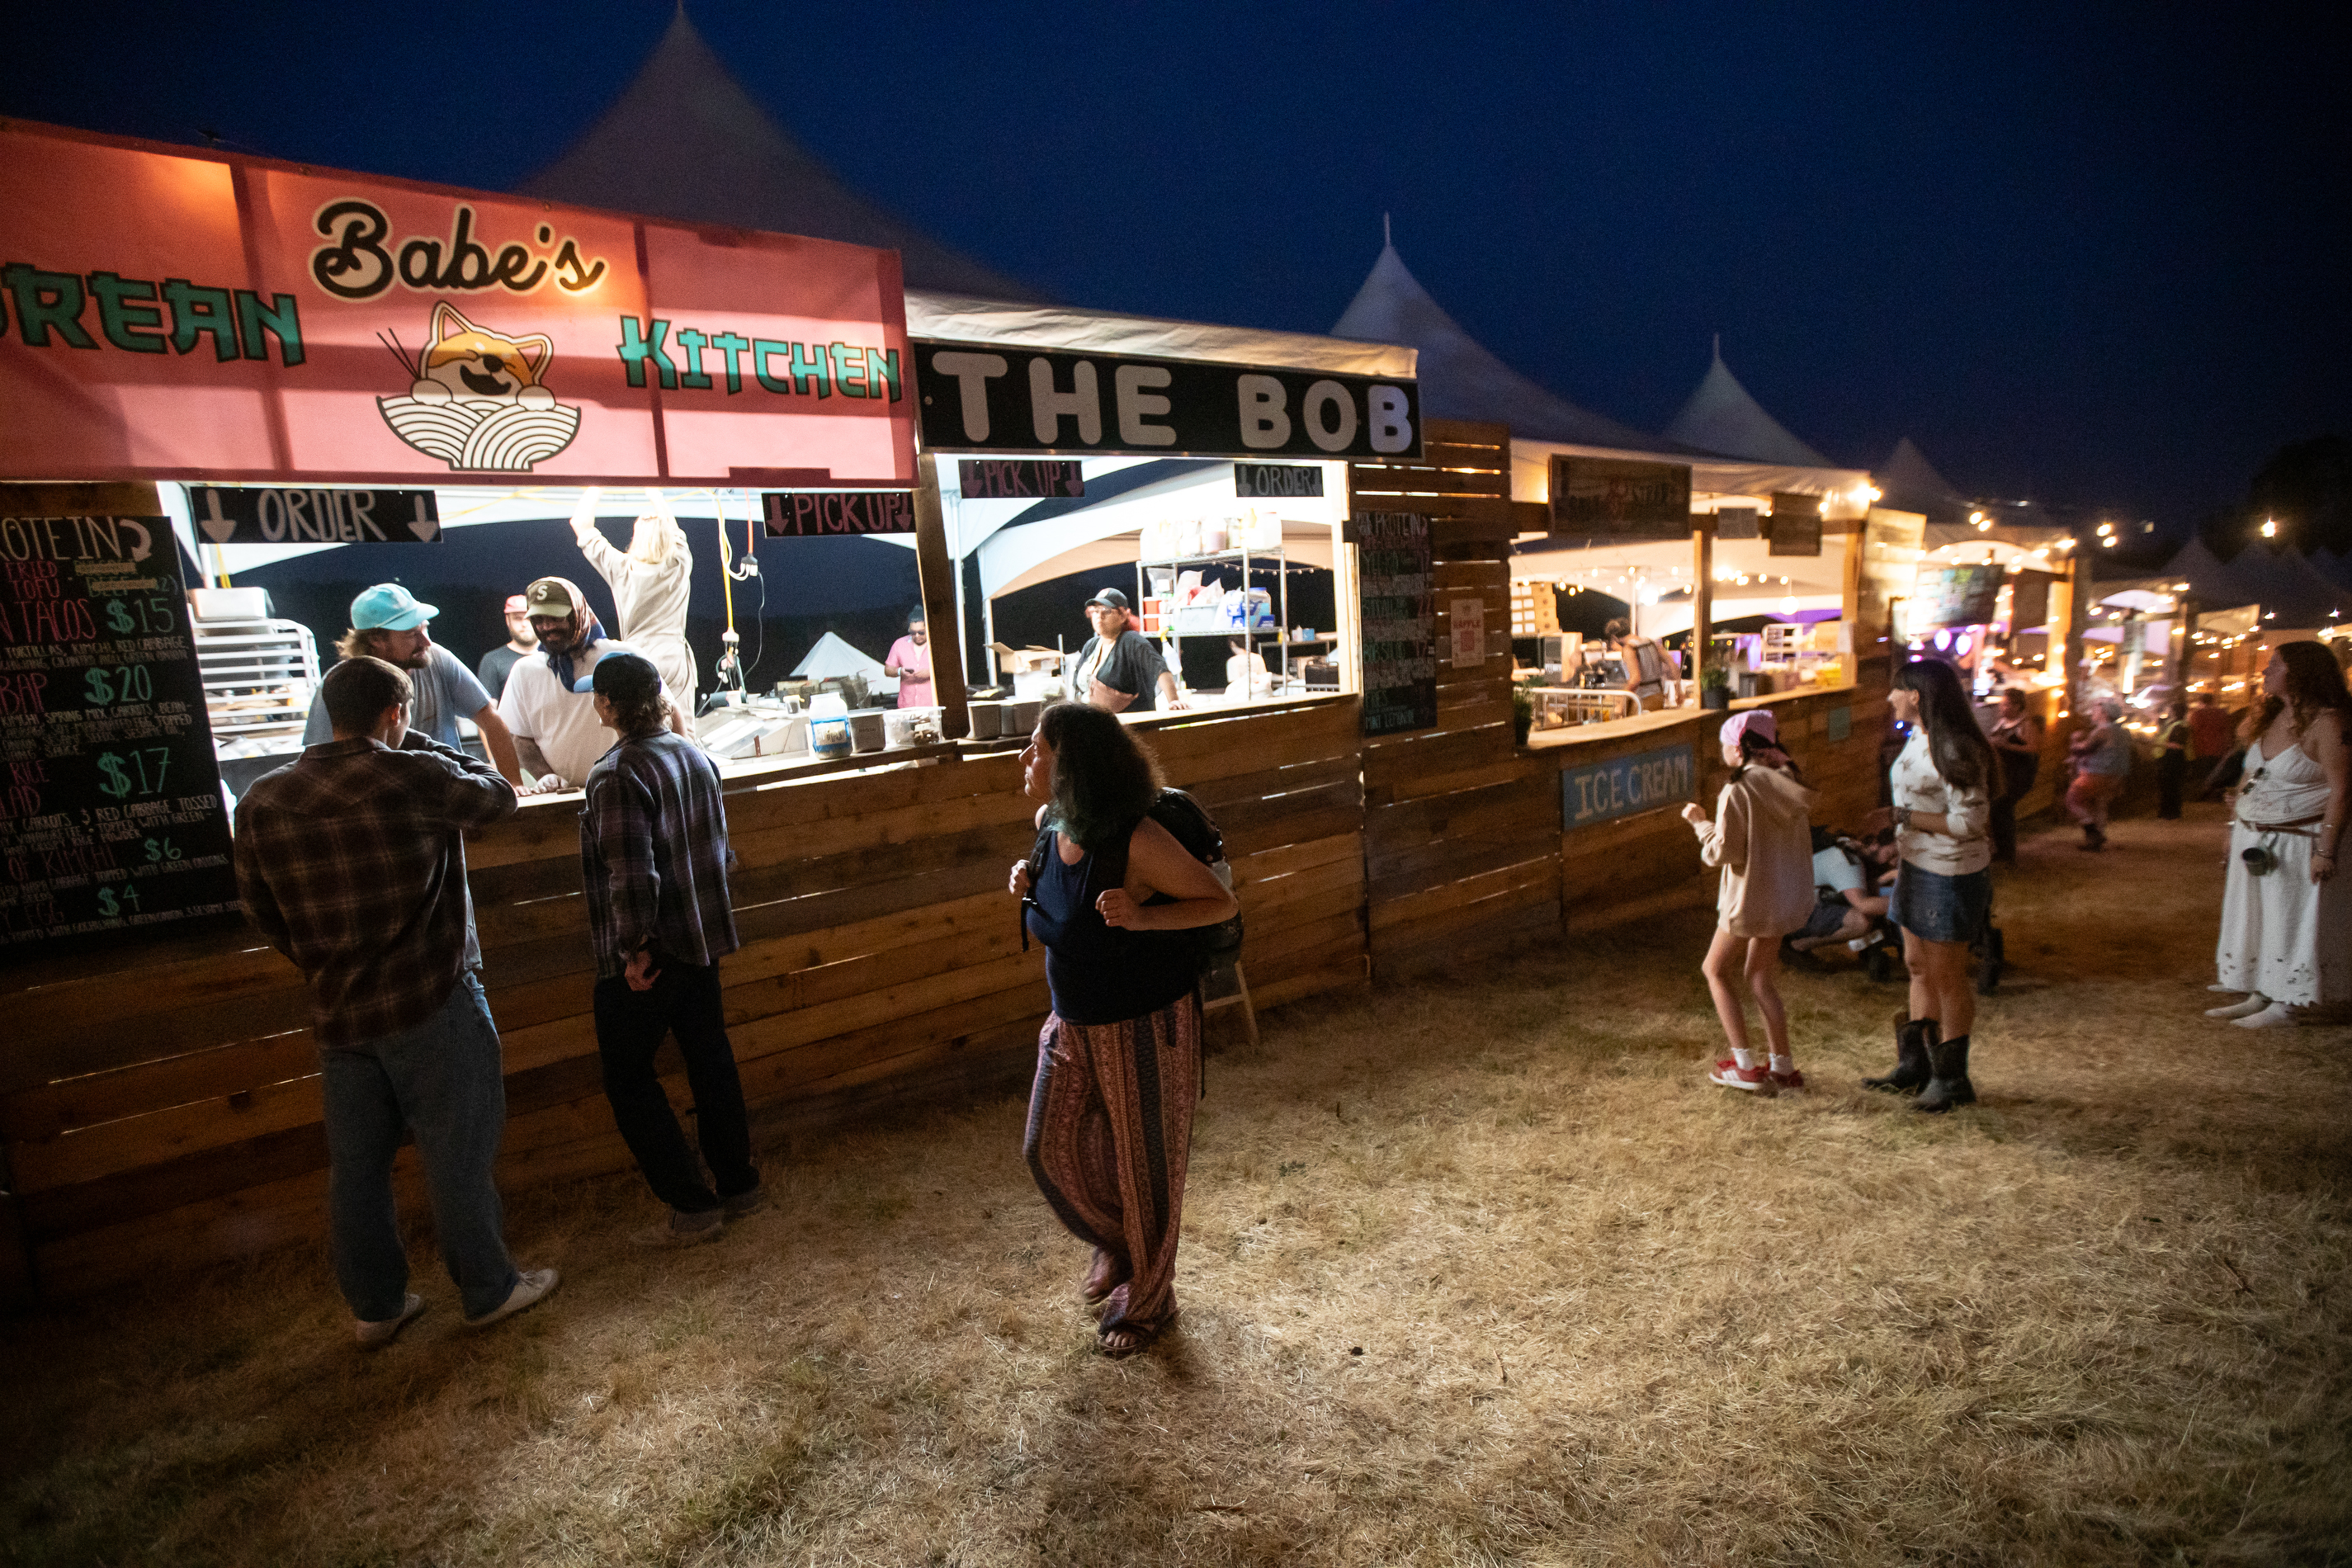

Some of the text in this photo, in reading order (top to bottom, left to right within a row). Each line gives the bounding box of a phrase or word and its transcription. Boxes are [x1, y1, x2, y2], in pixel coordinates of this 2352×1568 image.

[313, 200, 606, 300] Babe's
[0, 262, 306, 367] REAN
[617, 315, 902, 404] KITCHEN
[931, 351, 1414, 453] THE BOB
[985, 459, 1061, 497] PICK UP
[1255, 463, 1311, 495] ORDER
[257, 489, 387, 542] ORDER
[795, 494, 858, 536] PICK
[0, 516, 122, 562] OTEIN
[8, 578, 60, 600] TOFU
[14, 598, 97, 644] TACOS
[106, 597, 174, 635] $15
[84, 664, 153, 706] $20
[8, 747, 172, 799] RICE $17
[1575, 753, 1688, 821] ICE CREAM
[95, 806, 121, 822] RED
[123, 798, 172, 819] CABBAGE
[177, 793, 218, 811] TOSSED
[135, 812, 170, 829] WITH
[40, 843, 117, 876] KIMCHI
[144, 837, 182, 862] $6
[97, 884, 140, 918] $4
